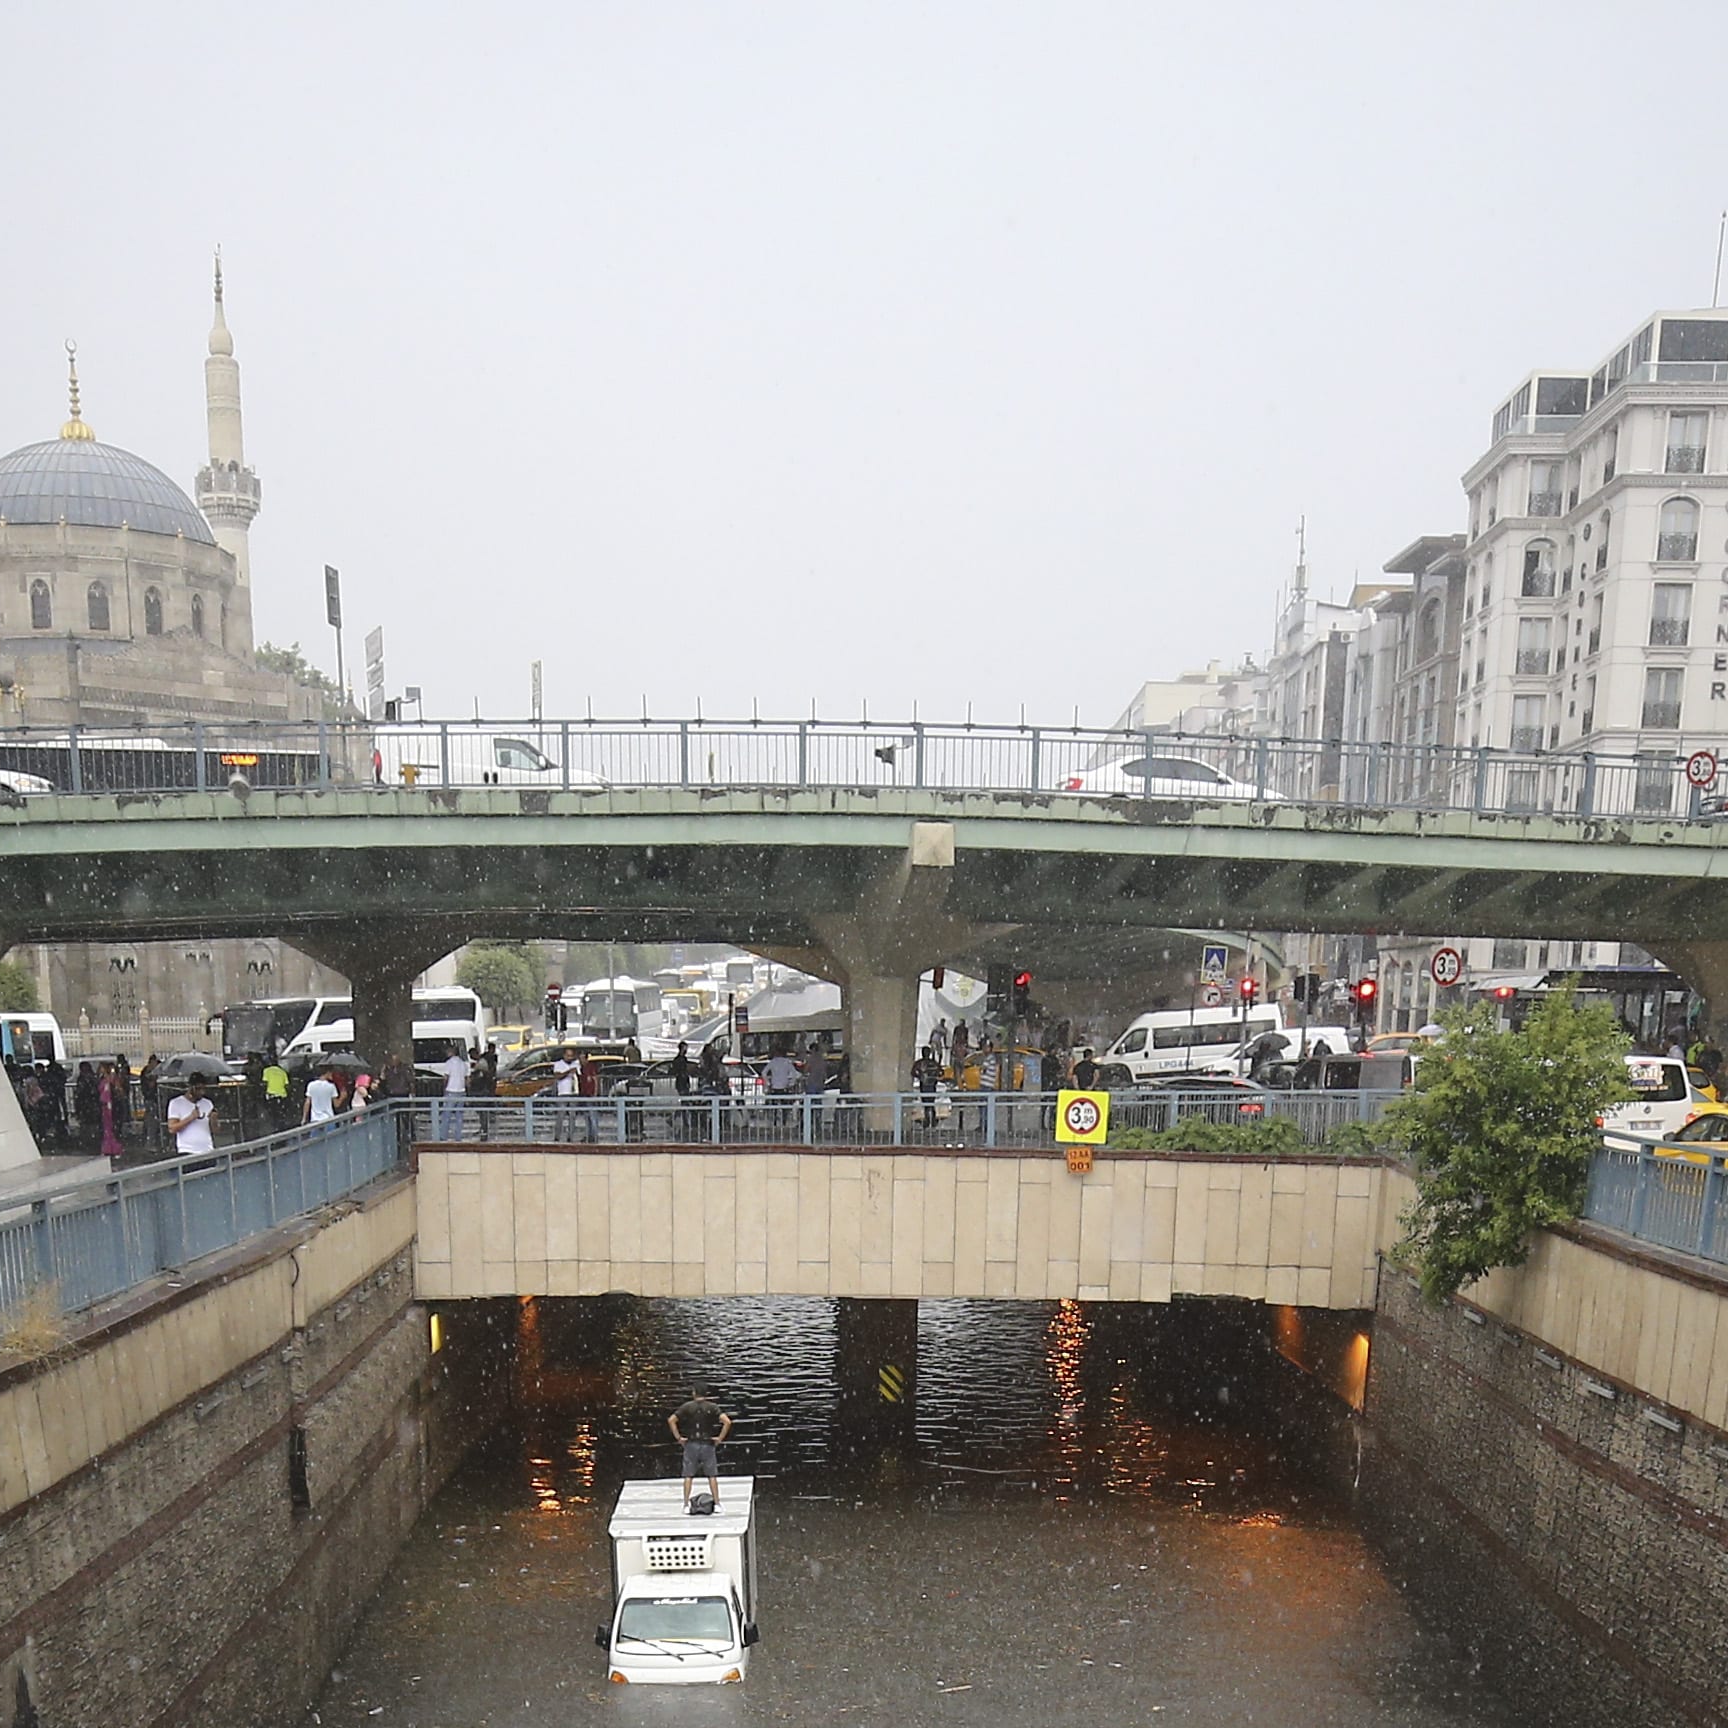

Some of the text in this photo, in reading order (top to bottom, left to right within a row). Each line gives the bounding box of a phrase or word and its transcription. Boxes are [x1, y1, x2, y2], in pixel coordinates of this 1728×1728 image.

[1693, 760, 1701, 776] 3
[1437, 957, 1446, 975] 3
[1071, 1106, 1081, 1124] 3
